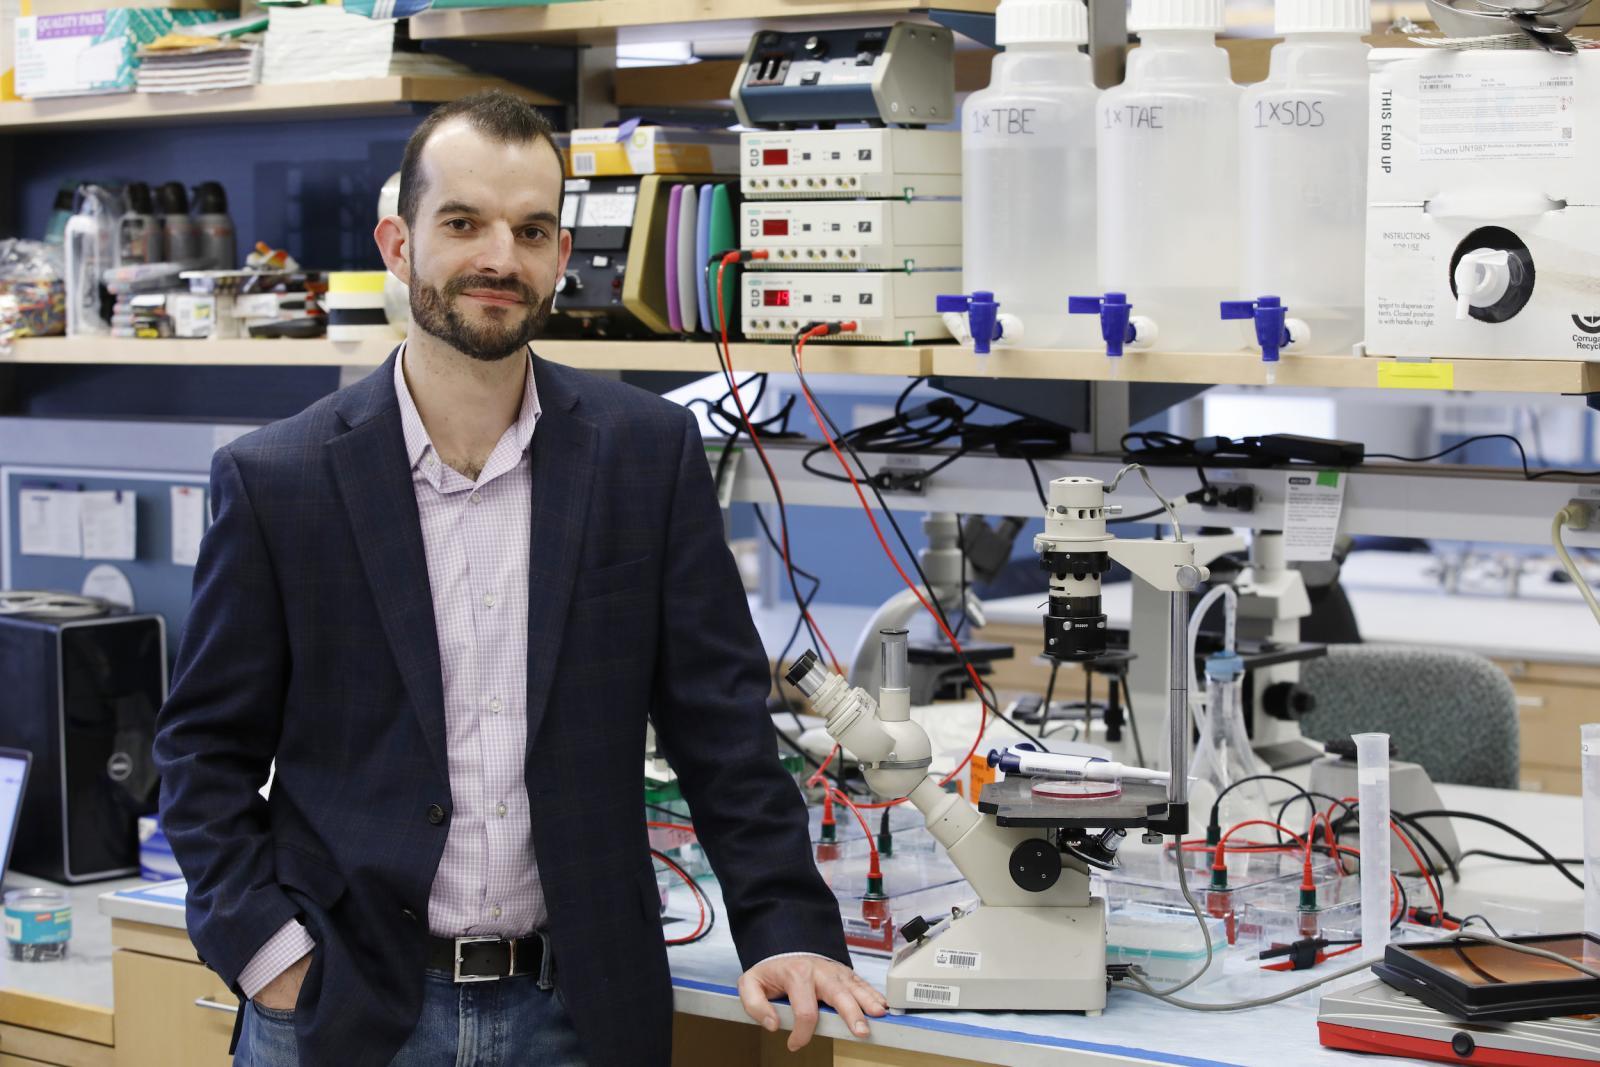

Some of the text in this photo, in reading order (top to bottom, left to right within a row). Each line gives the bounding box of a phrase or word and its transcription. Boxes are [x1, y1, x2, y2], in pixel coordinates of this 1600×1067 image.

[38, 13, 105, 32] QUALITY PARK
[1381, 89, 1392, 174] THIS END UP
[1383, 232, 1431, 240] INSTRUCTIONS
